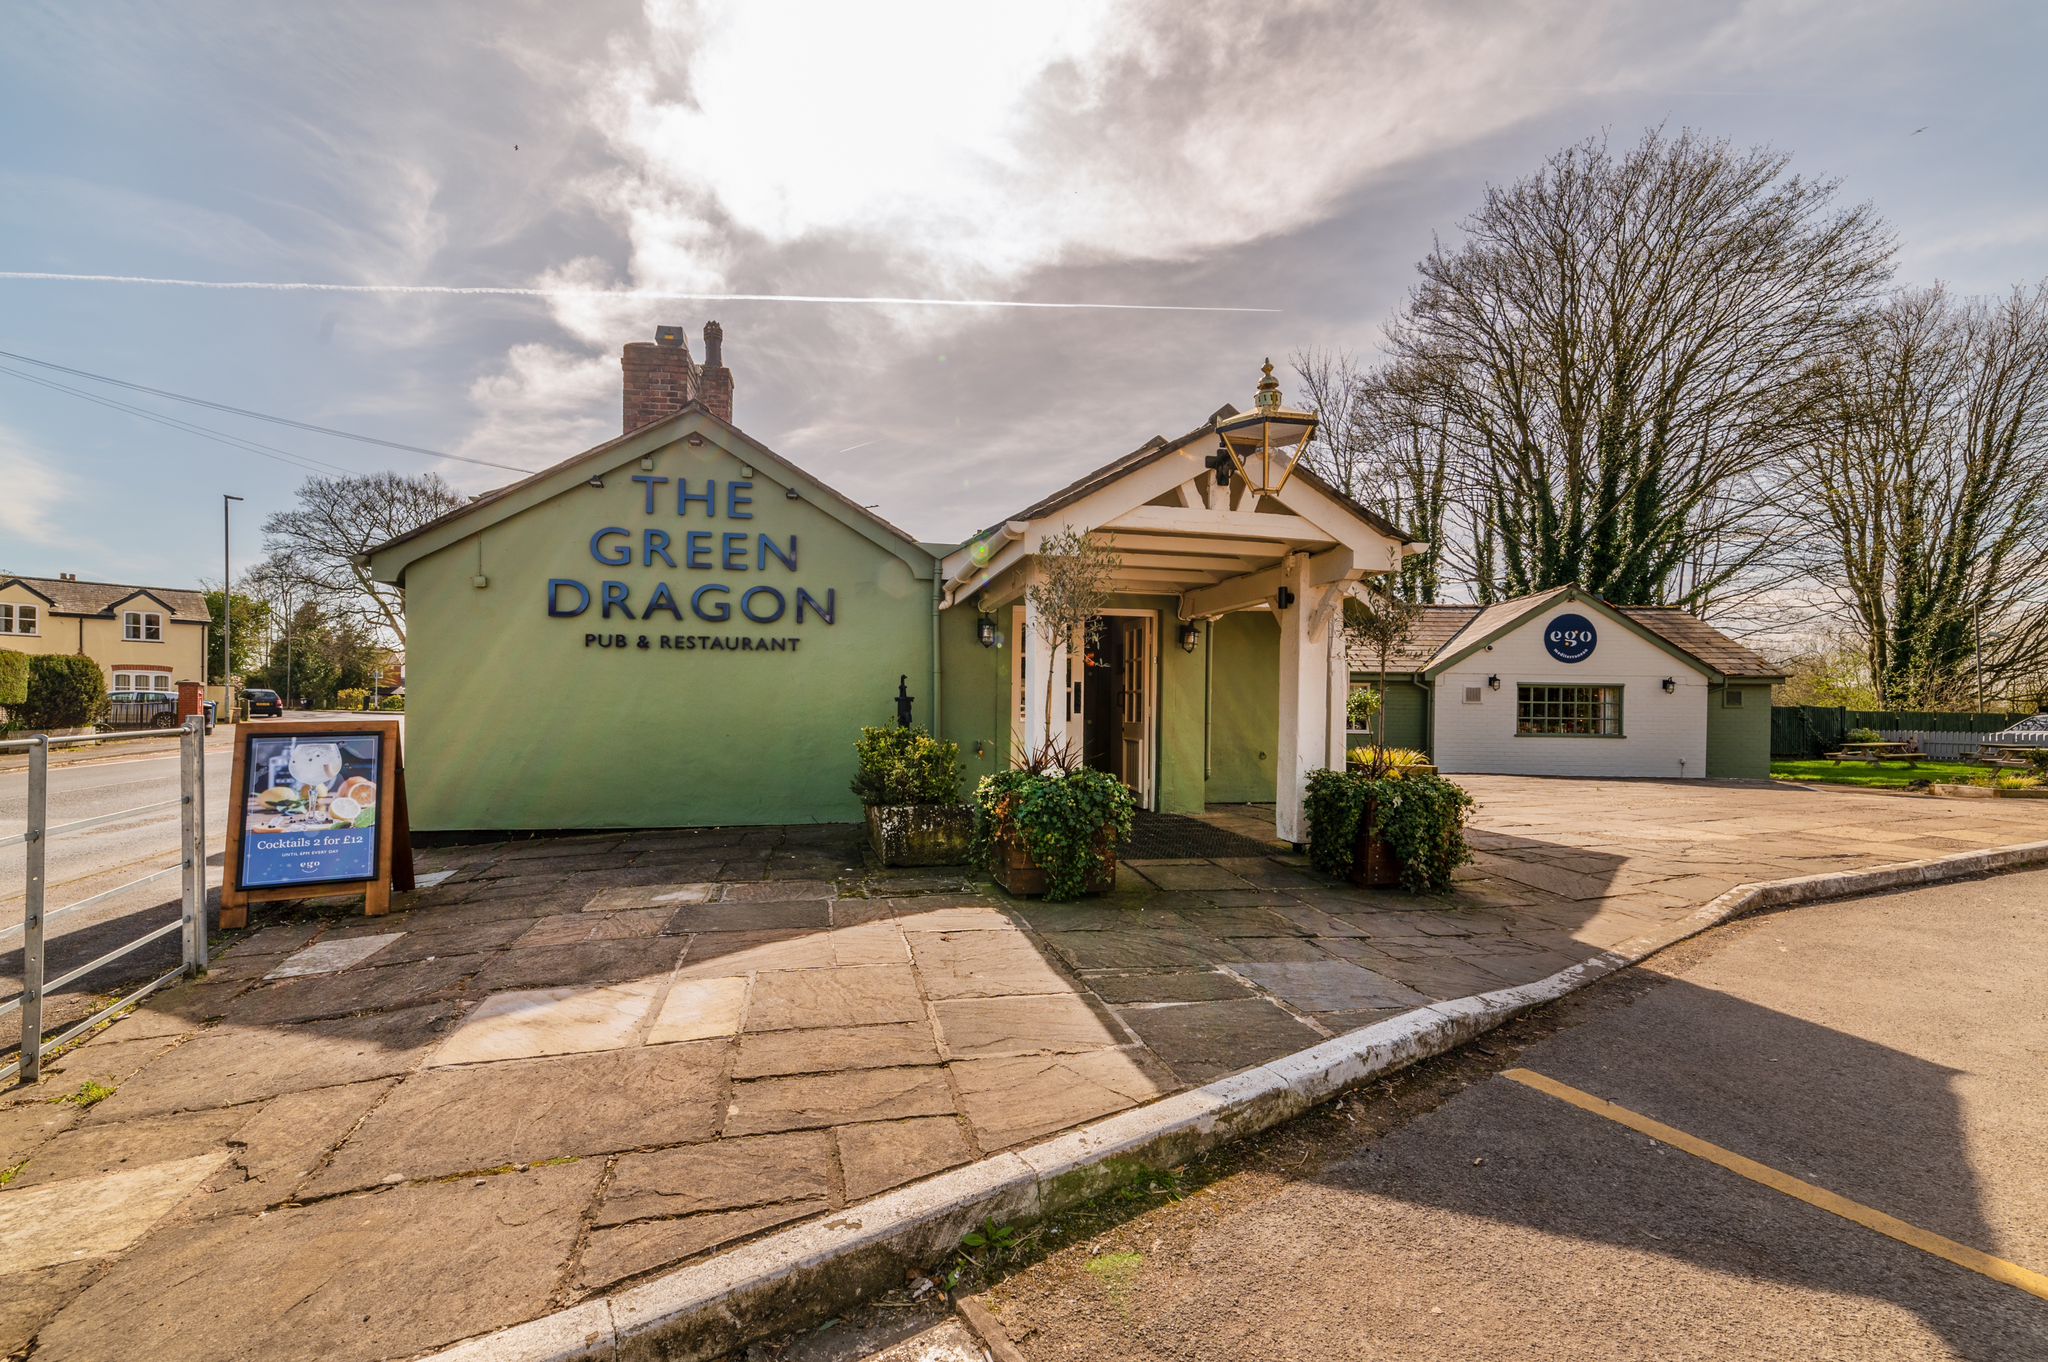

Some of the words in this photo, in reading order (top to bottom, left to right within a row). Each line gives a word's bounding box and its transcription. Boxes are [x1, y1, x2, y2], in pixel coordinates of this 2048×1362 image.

[632, 475, 753, 519] THE
[589, 527, 797, 572] GREEN
[548, 578, 835, 625] DRAGON
[584, 633, 628, 649] PUB
[636, 635, 650, 649] &
[660, 635, 800, 652] RESTAURANT
[1550, 630, 1592, 647] ego
[257, 837, 311, 850] Cocktails
[313, 838, 321, 846] 2
[323, 835, 340, 846] for
[343, 835, 363, 844] £12
[300, 860, 320, 869] ego
